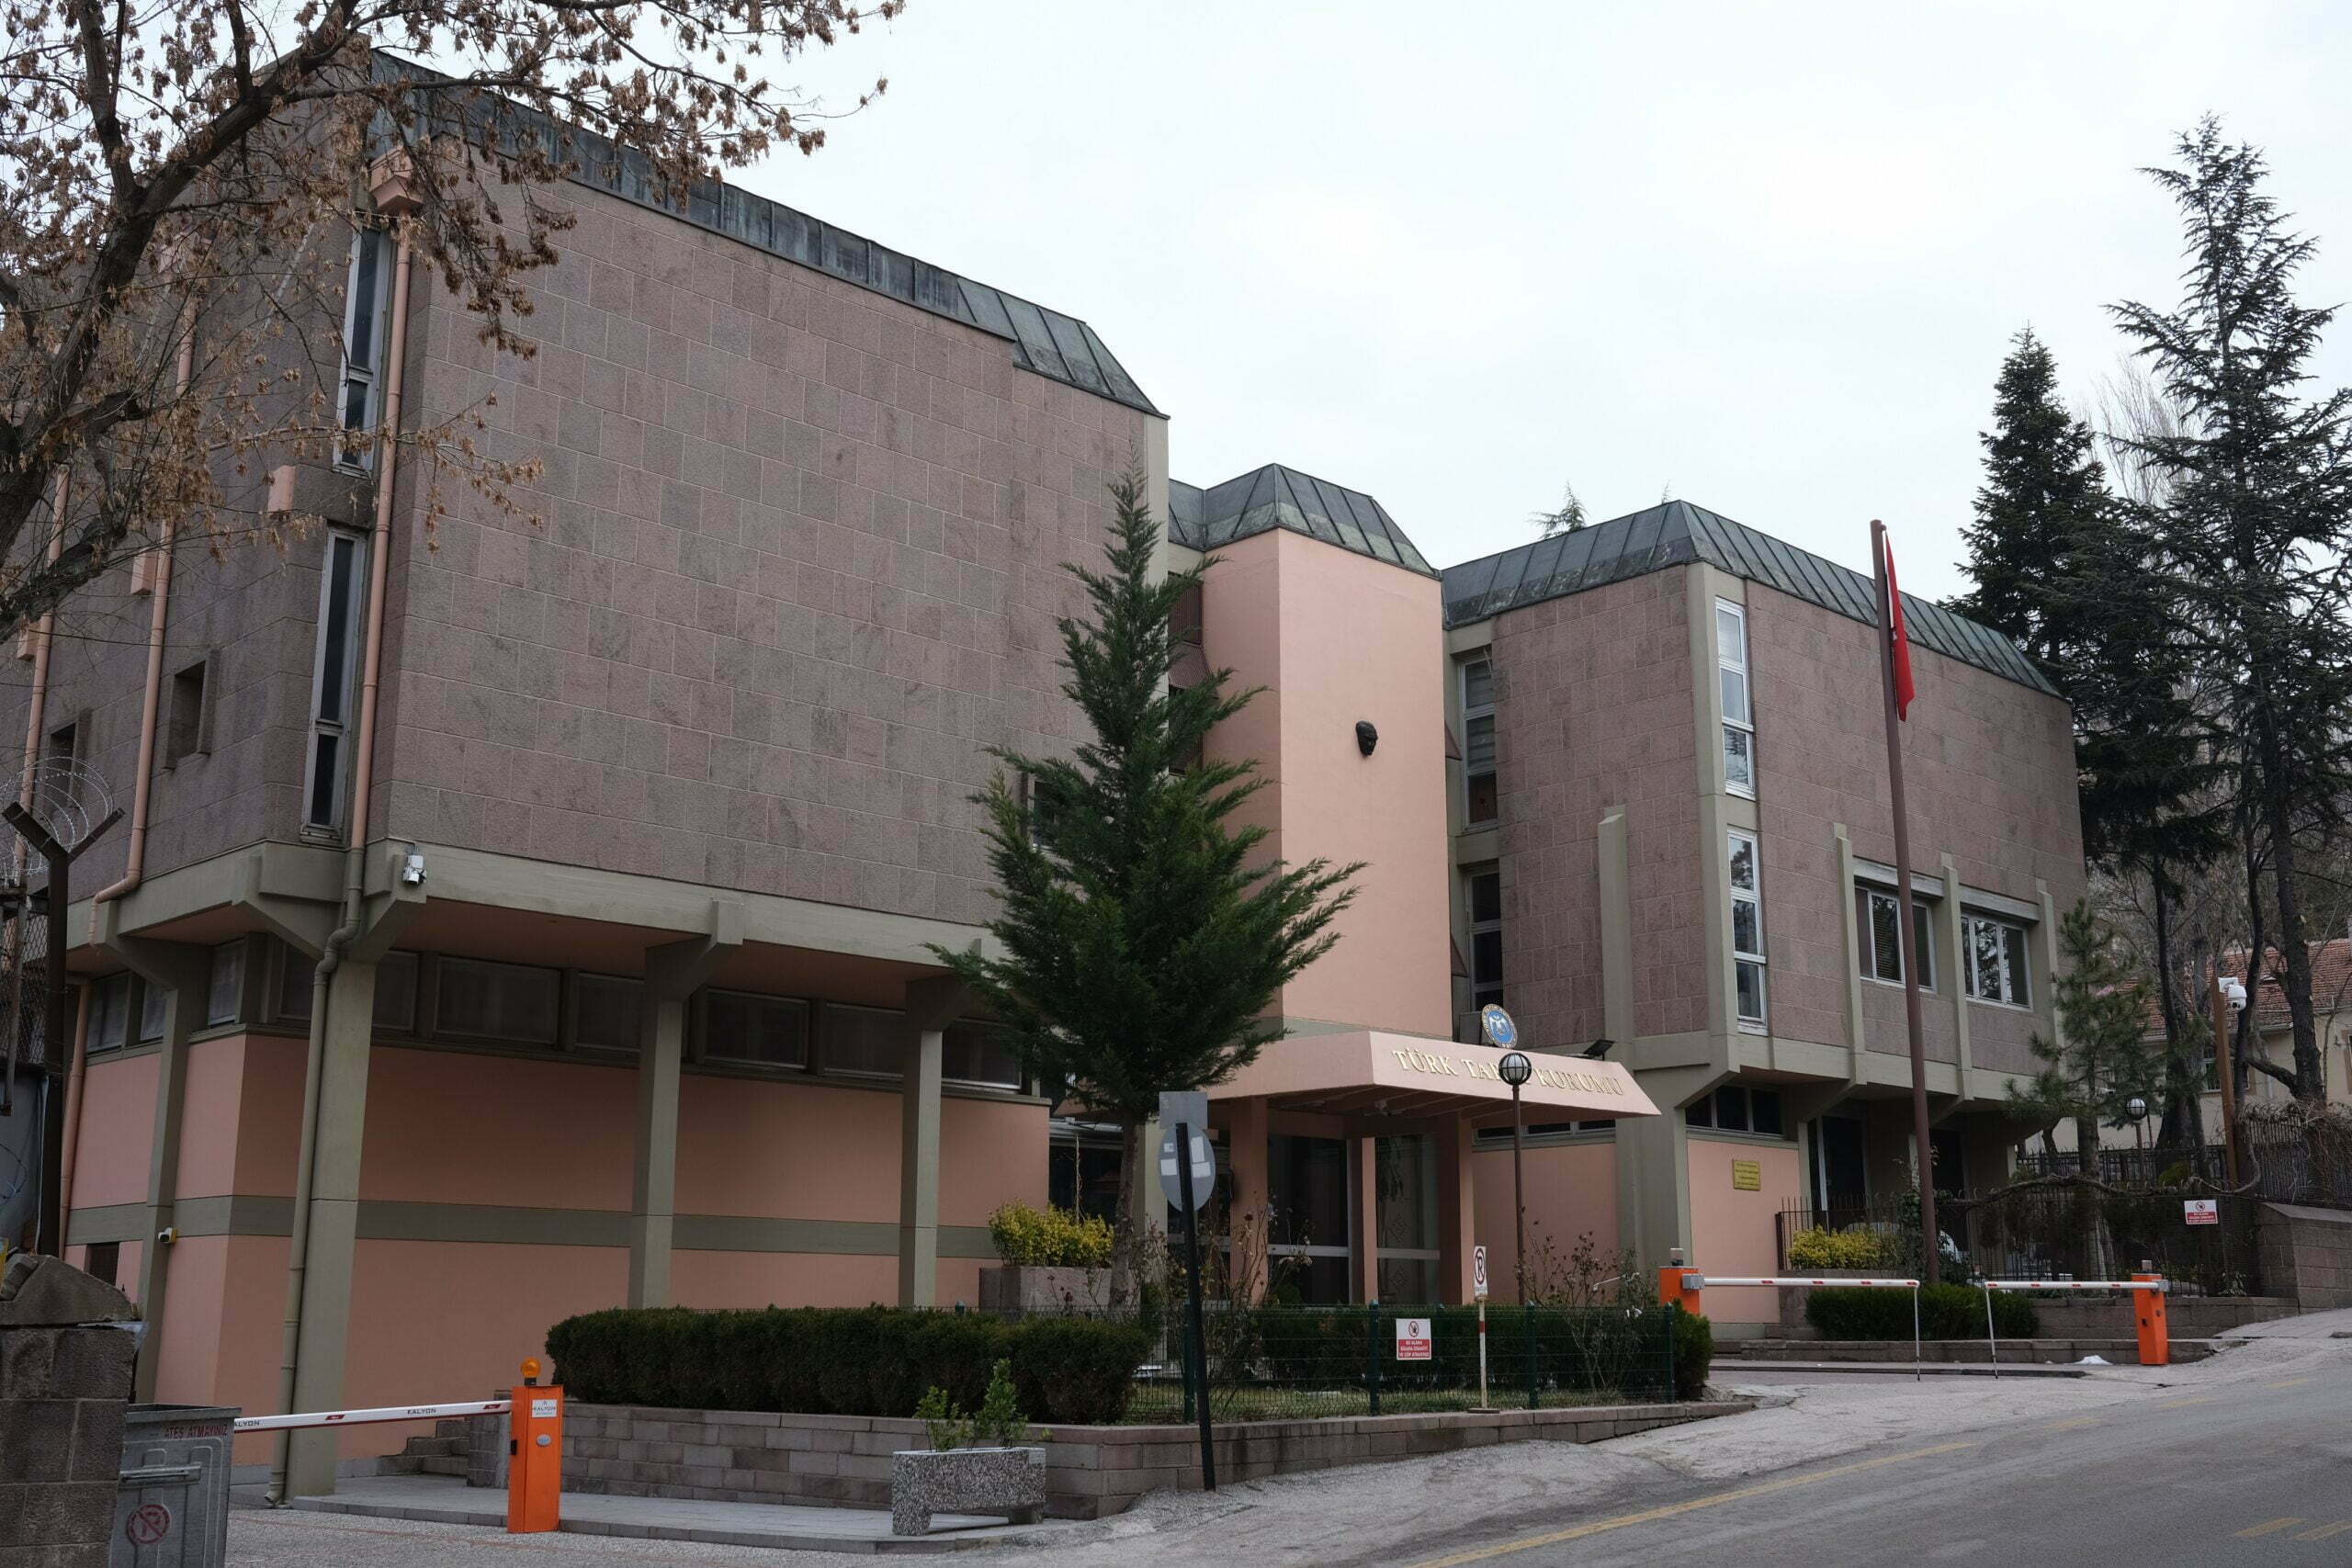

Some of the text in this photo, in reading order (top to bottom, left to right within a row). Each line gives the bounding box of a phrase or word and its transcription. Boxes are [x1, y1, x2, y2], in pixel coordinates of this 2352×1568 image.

[1392, 1046, 1459, 1077] TÜRK
[1533, 1067, 1624, 1095] KURUMU
[234, 1419, 260, 1427] ALYON
